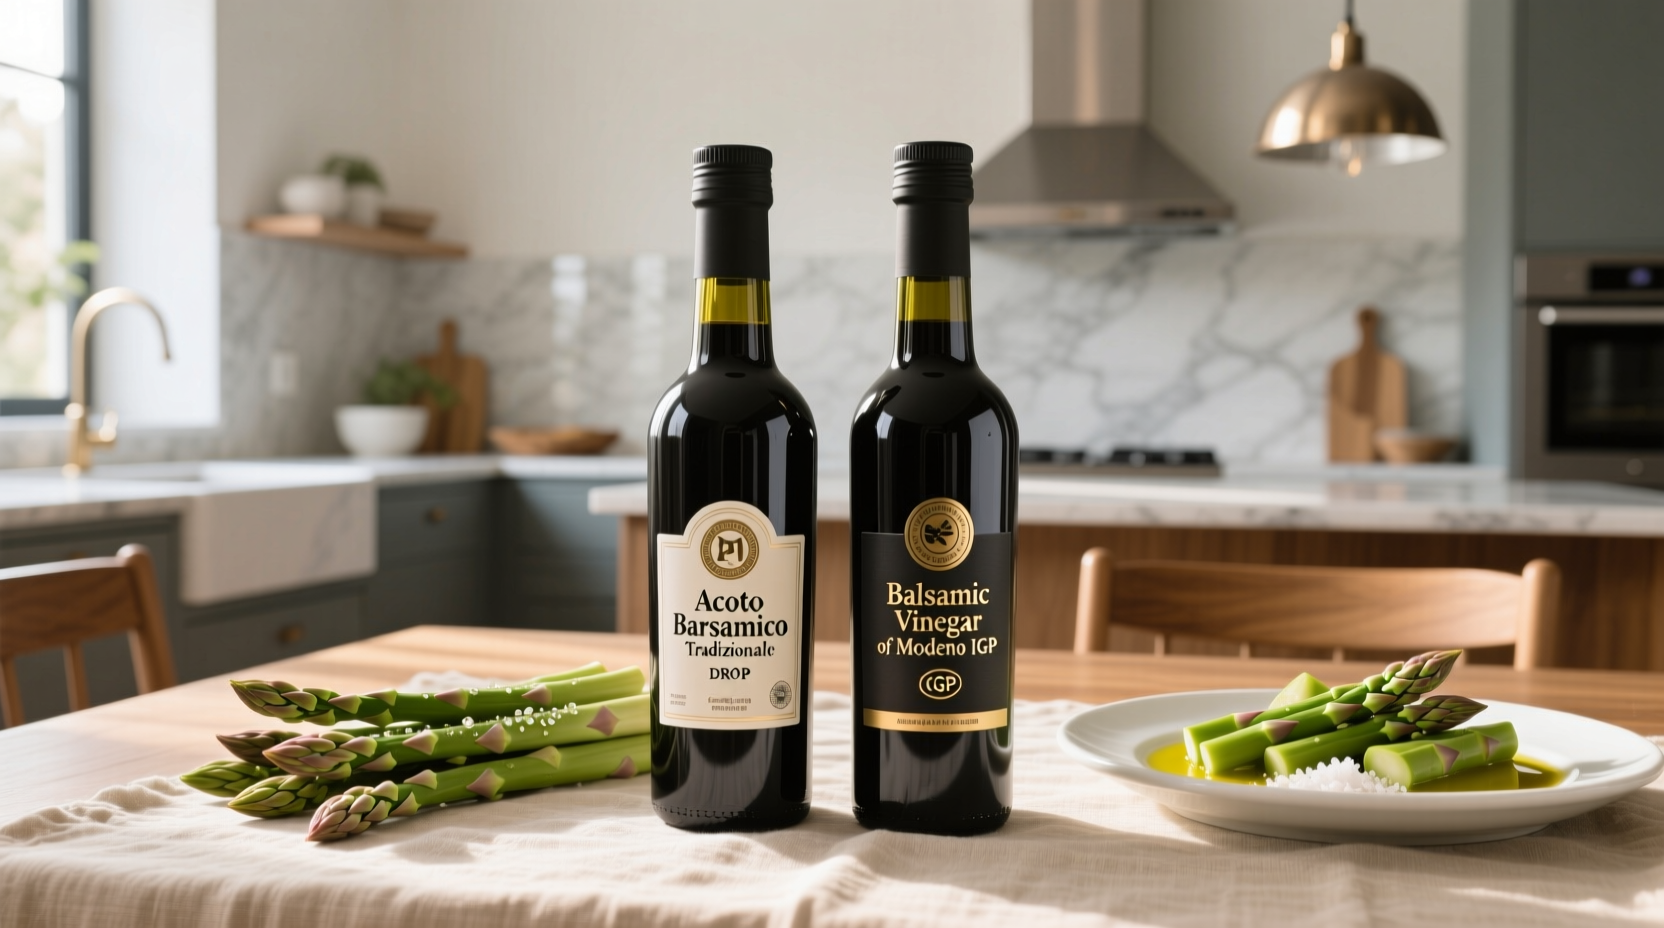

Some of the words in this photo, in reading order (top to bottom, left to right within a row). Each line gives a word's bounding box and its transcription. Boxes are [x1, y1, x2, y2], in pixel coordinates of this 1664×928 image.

[695, 589, 764, 612] Acoto
[886, 582, 990, 606] Balsamic
[673, 613, 788, 637] Barsamico
[894, 610, 983, 638] Vinegar
[685, 641, 775, 657] Tradizionale
[877, 637, 893, 655] of
[896, 637, 966, 656] Modeno
[971, 637, 998, 655] IGP
[709, 667, 751, 680] DROP
